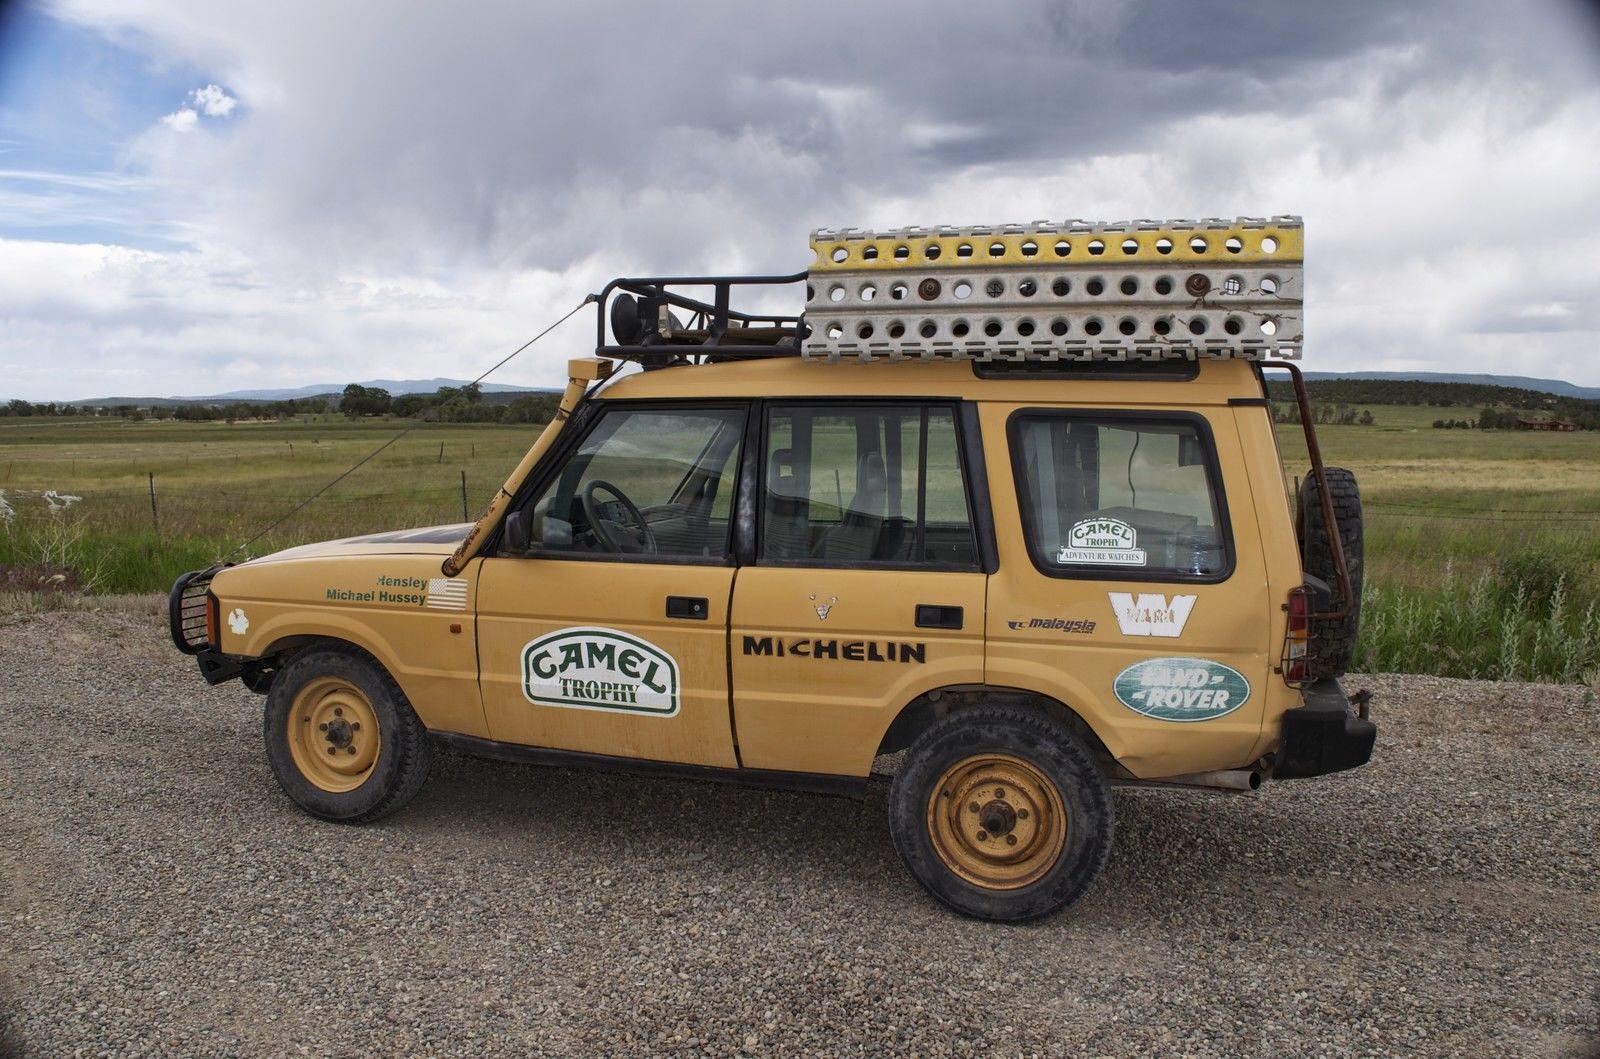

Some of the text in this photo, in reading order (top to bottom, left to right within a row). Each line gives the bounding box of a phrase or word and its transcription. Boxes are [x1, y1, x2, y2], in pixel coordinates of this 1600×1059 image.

[1074, 523, 1130, 541] CAMEL
[1086, 538, 1120, 547] TROPHY
[1064, 552, 1140, 561] ADVENTURE WATCHES
[326, 588, 426, 606] Michael Hussey
[1028, 617, 1096, 633] malaysia
[742, 635, 926, 664] MICHELIN
[531, 642, 667, 694] CAMEL
[558, 676, 640, 704] TROPHY
